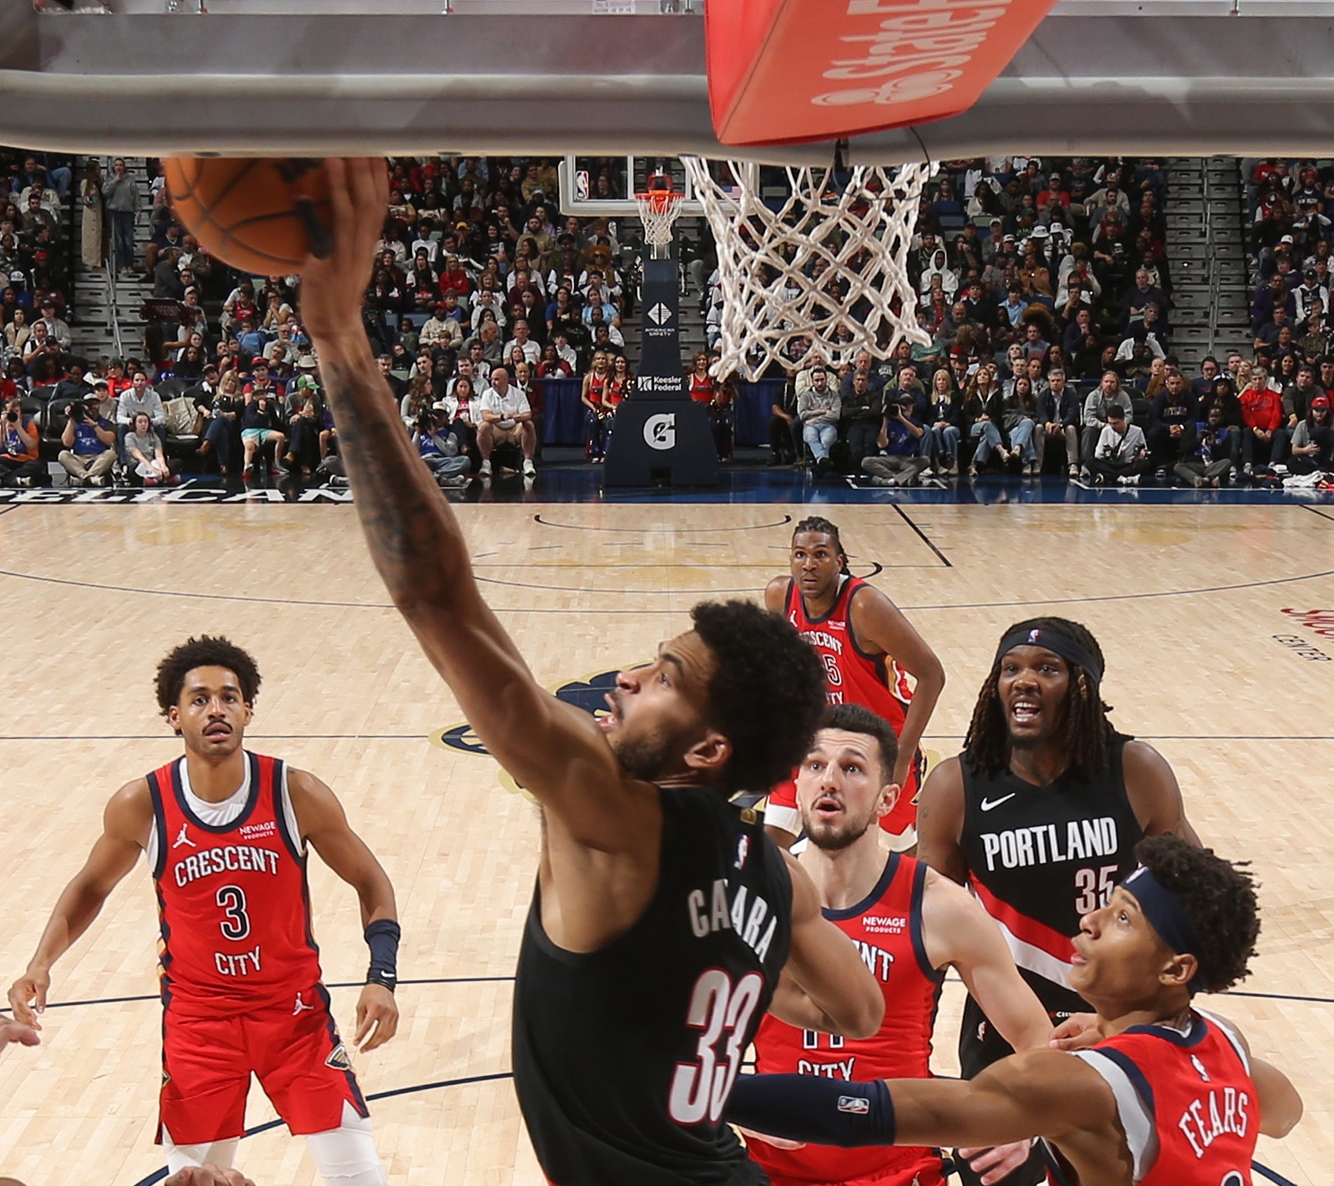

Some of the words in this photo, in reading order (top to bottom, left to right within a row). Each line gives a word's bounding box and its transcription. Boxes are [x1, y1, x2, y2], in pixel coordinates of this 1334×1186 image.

[653, 376, 682, 384] Keesler
[653, 383, 682, 391] Federal
[1272, 633, 1333, 661] CENTER
[821, 653, 842, 687] 5
[239, 821, 276, 836] NEWAGE
[243, 831, 274, 841] PRODUCTS
[979, 816, 1119, 872] PORTLAND
[174, 846, 280, 888] CRESCENT
[1074, 864, 1120, 915] 35
[216, 884, 251, 941] 3
[687, 878, 778, 964] CAARA
[862, 916, 906, 928] NEWAGE
[865, 926, 901, 935] PRODUCTS
[214, 945, 262, 977] CITY
[666, 965, 765, 1125] 33
[1178, 1087, 1249, 1159] FEARS
